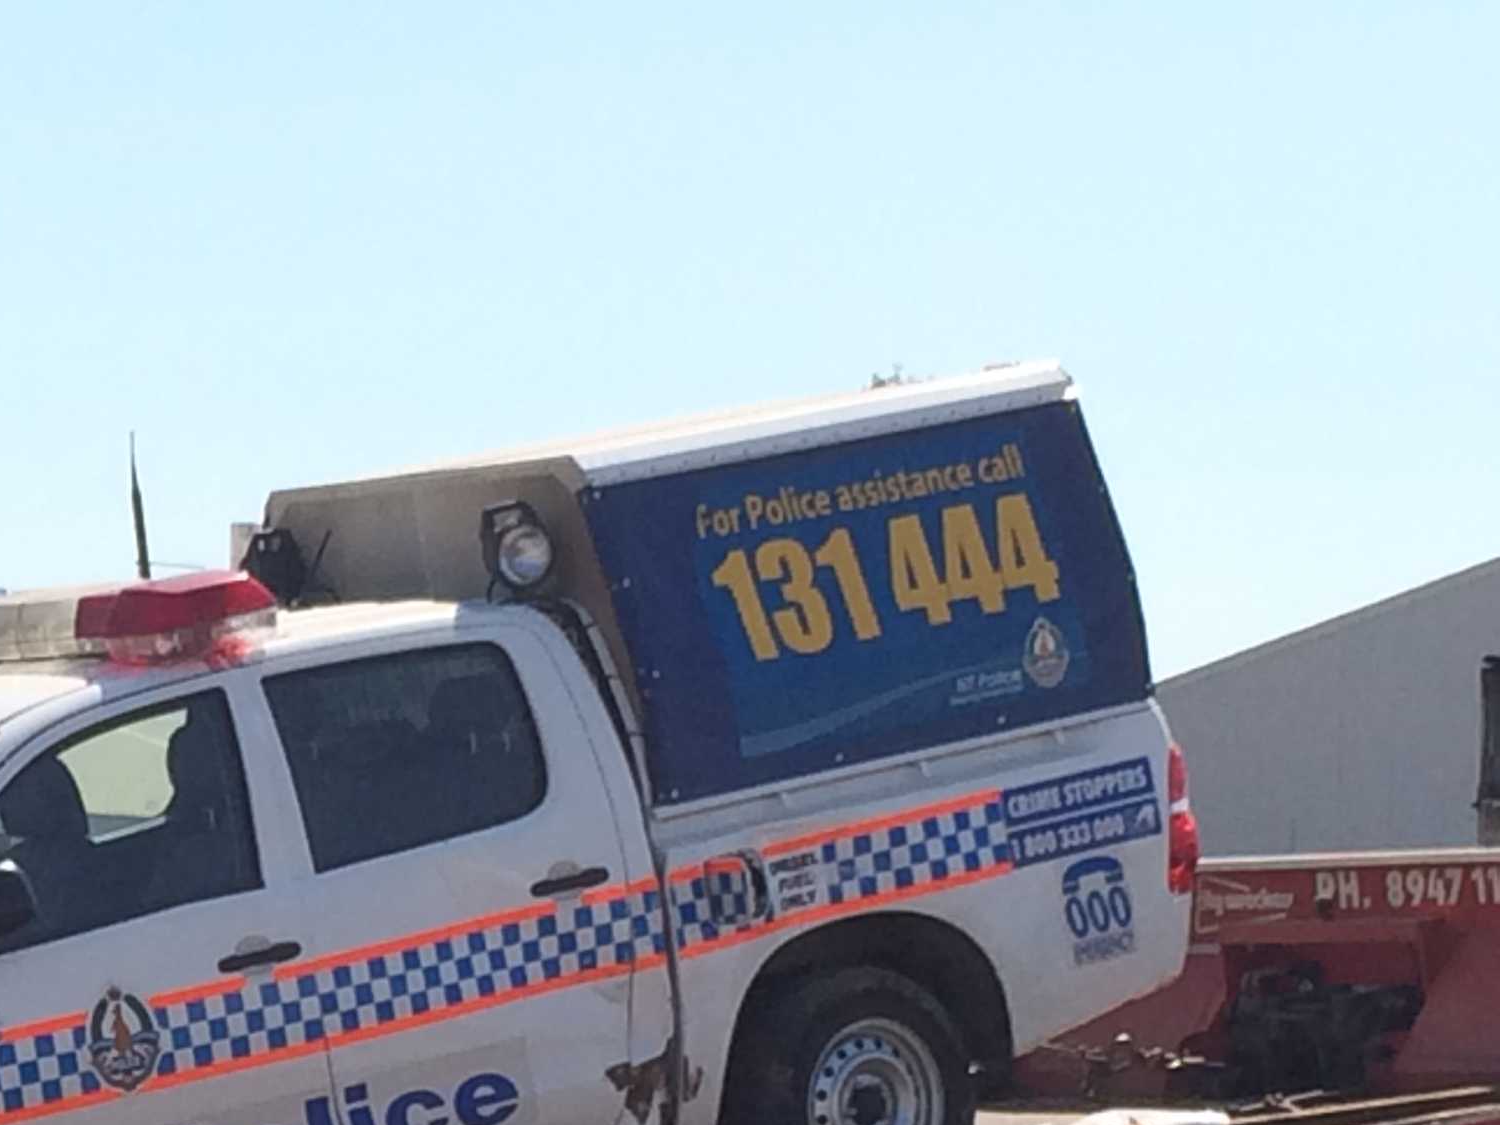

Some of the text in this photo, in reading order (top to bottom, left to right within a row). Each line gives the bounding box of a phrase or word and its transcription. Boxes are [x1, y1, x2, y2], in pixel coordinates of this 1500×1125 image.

[696, 443, 1026, 538] For Police assistance call
[712, 493, 1061, 661] 131 444
[1008, 765, 1147, 818] CRIME STOPPERS
[1058, 821, 1092, 849] 333
[1065, 887, 1132, 938] 000
[1314, 869, 1372, 910] PH.
[1386, 867, 1464, 908] 8947
